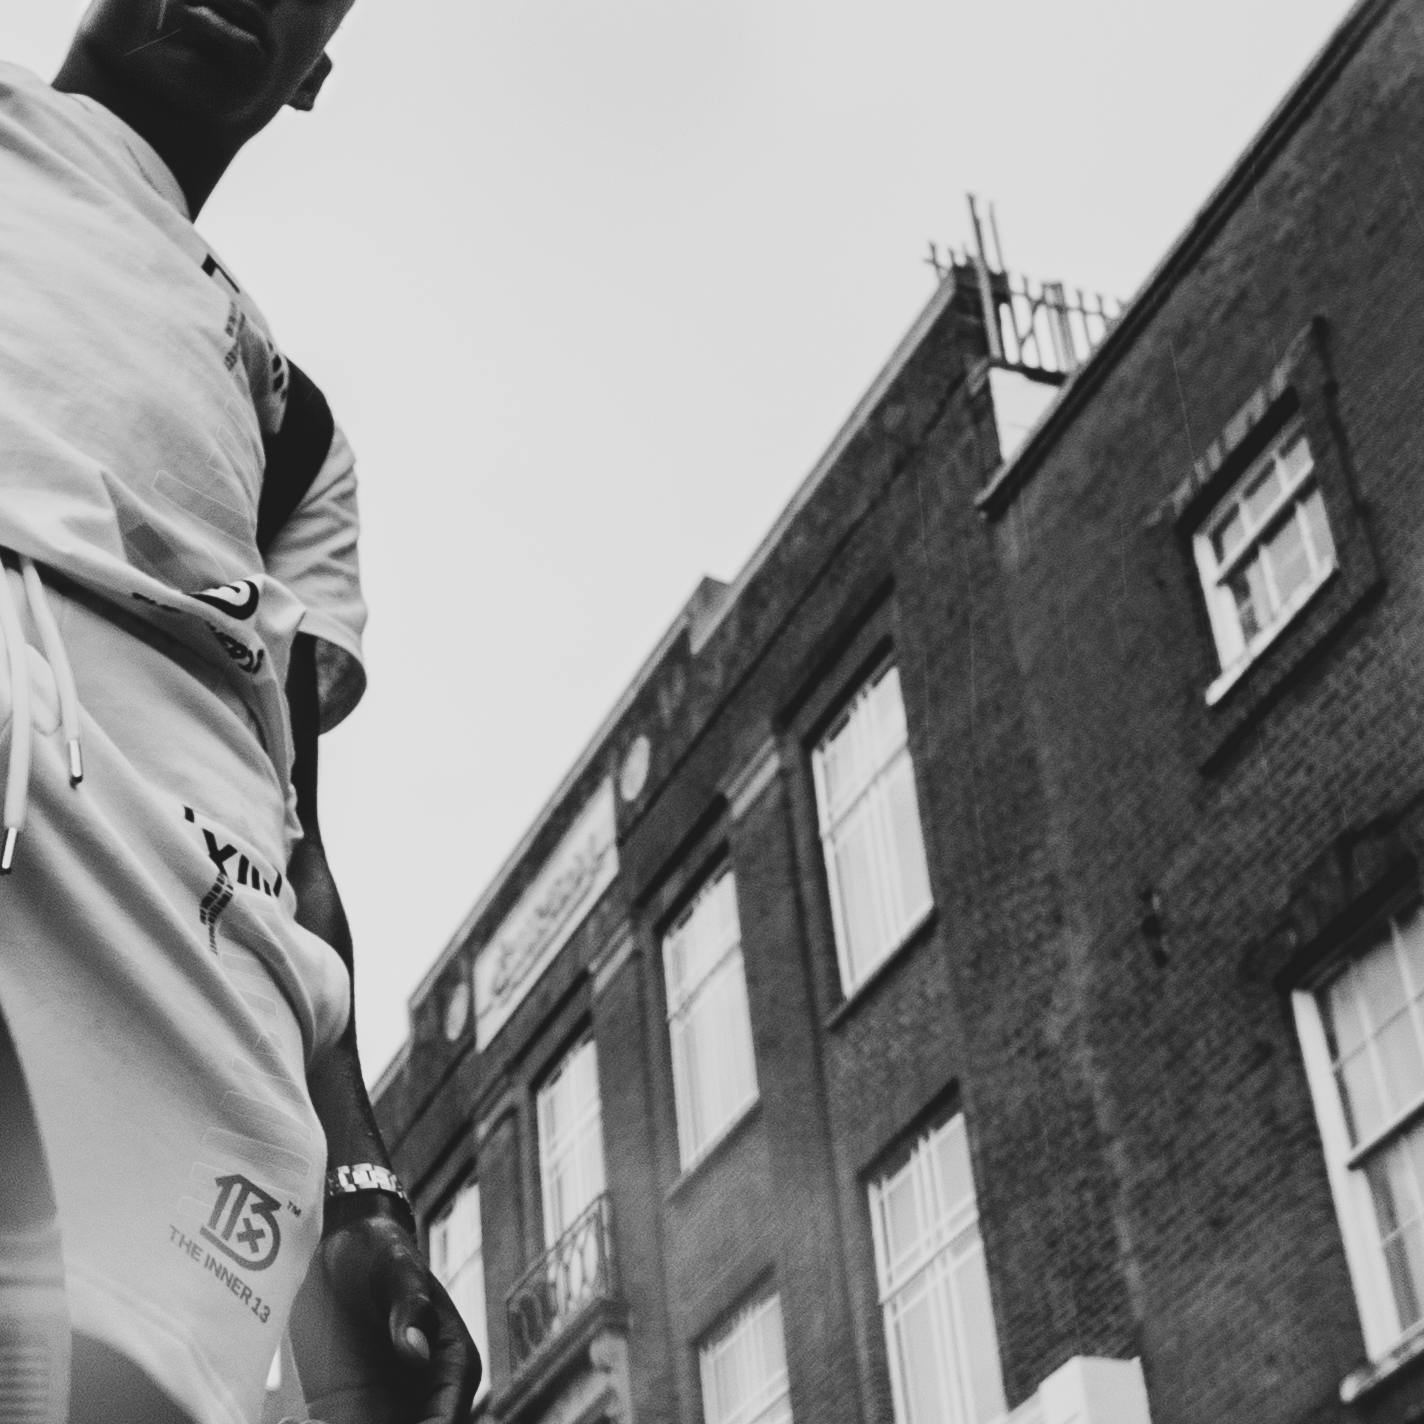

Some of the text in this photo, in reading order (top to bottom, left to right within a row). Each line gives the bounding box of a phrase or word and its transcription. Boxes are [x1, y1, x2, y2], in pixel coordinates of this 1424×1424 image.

[169, 1224, 271, 1324] THE INNER 13
